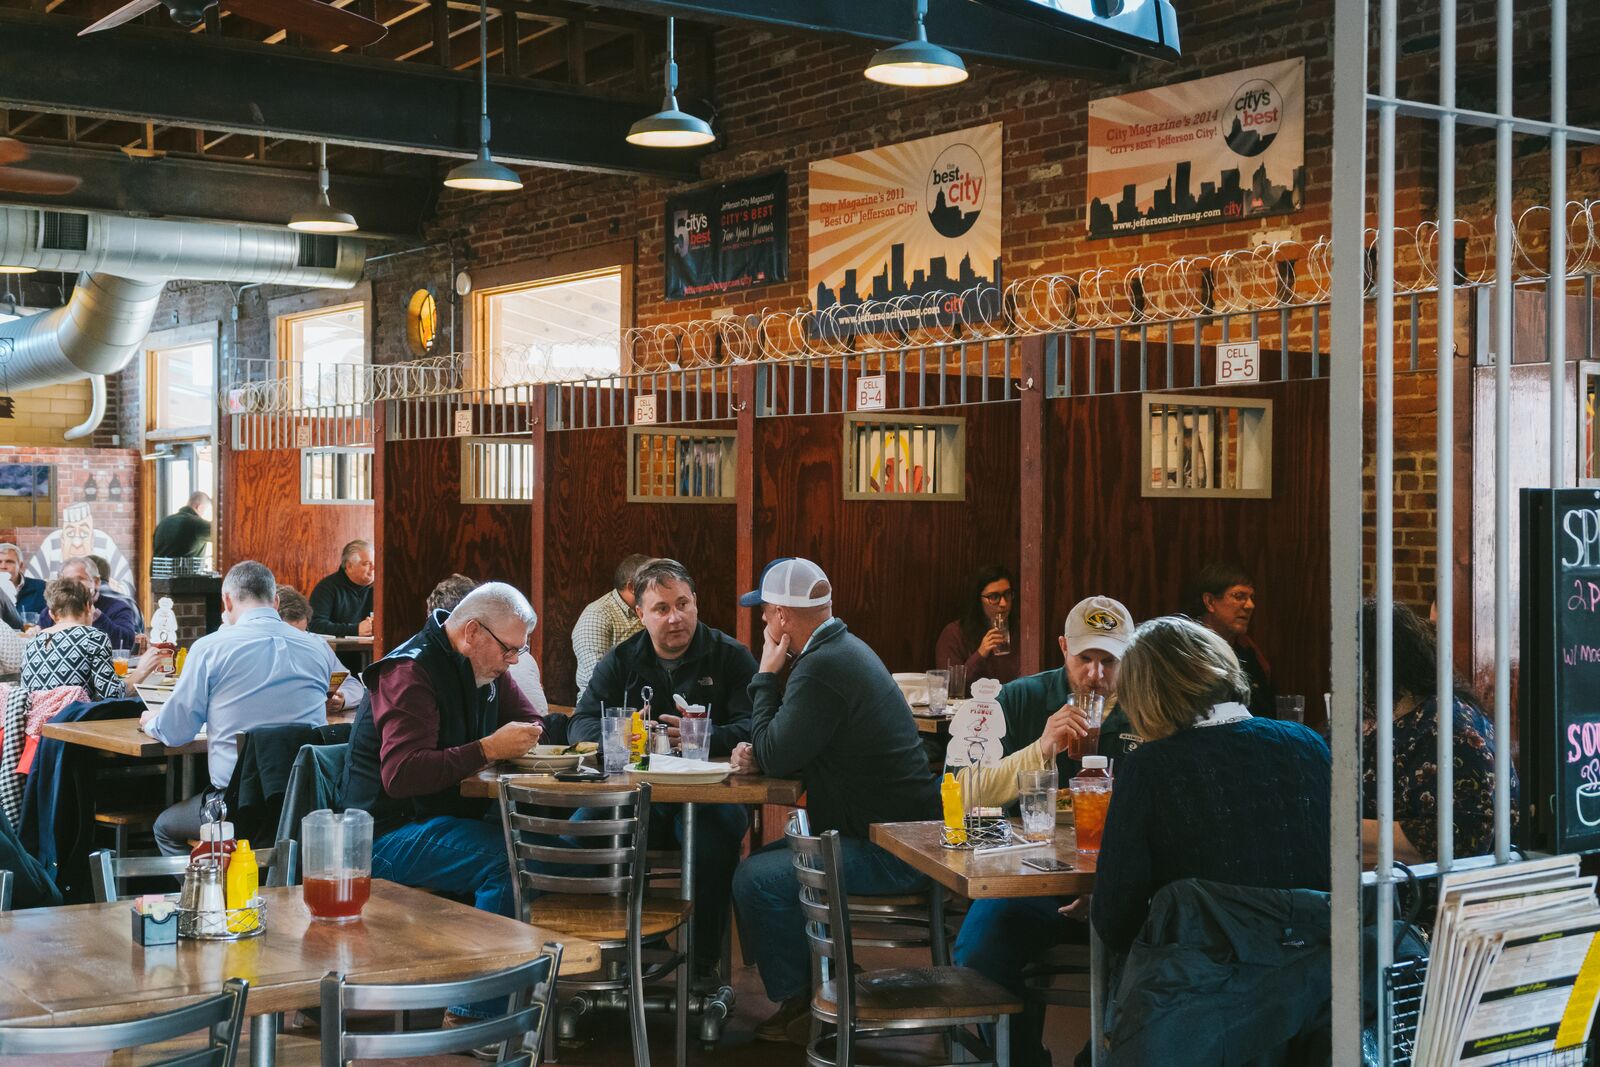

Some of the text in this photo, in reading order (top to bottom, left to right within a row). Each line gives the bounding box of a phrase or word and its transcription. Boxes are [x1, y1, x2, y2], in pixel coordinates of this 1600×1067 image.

[1106, 109, 1219, 144] City Magazine's 2014
[1242, 108, 1279, 127] best
[1157, 131, 1195, 149] Jefferson
[1195, 126, 1217, 141] City!
[932, 166, 960, 185] best
[948, 172, 984, 205] city
[819, 187, 905, 215] City Magazine's 2011
[720, 204, 775, 227] CITY'S BEST
[859, 208, 896, 224] Jefferson
[896, 201, 918, 216] City!
[1112, 208, 1221, 231] www.jeffersoncitymag.com
[1223, 201, 1242, 217] city
[673, 209, 689, 257] 5
[689, 229, 711, 245] best
[944, 295, 965, 314] city
[1226, 347, 1249, 359] CELL
[1222, 359, 1254, 379] B-5
[864, 381, 879, 390] CELL
[860, 390, 882, 406] B-4
[637, 407, 654, 421] B-3
[1561, 508, 1600, 568] SP
